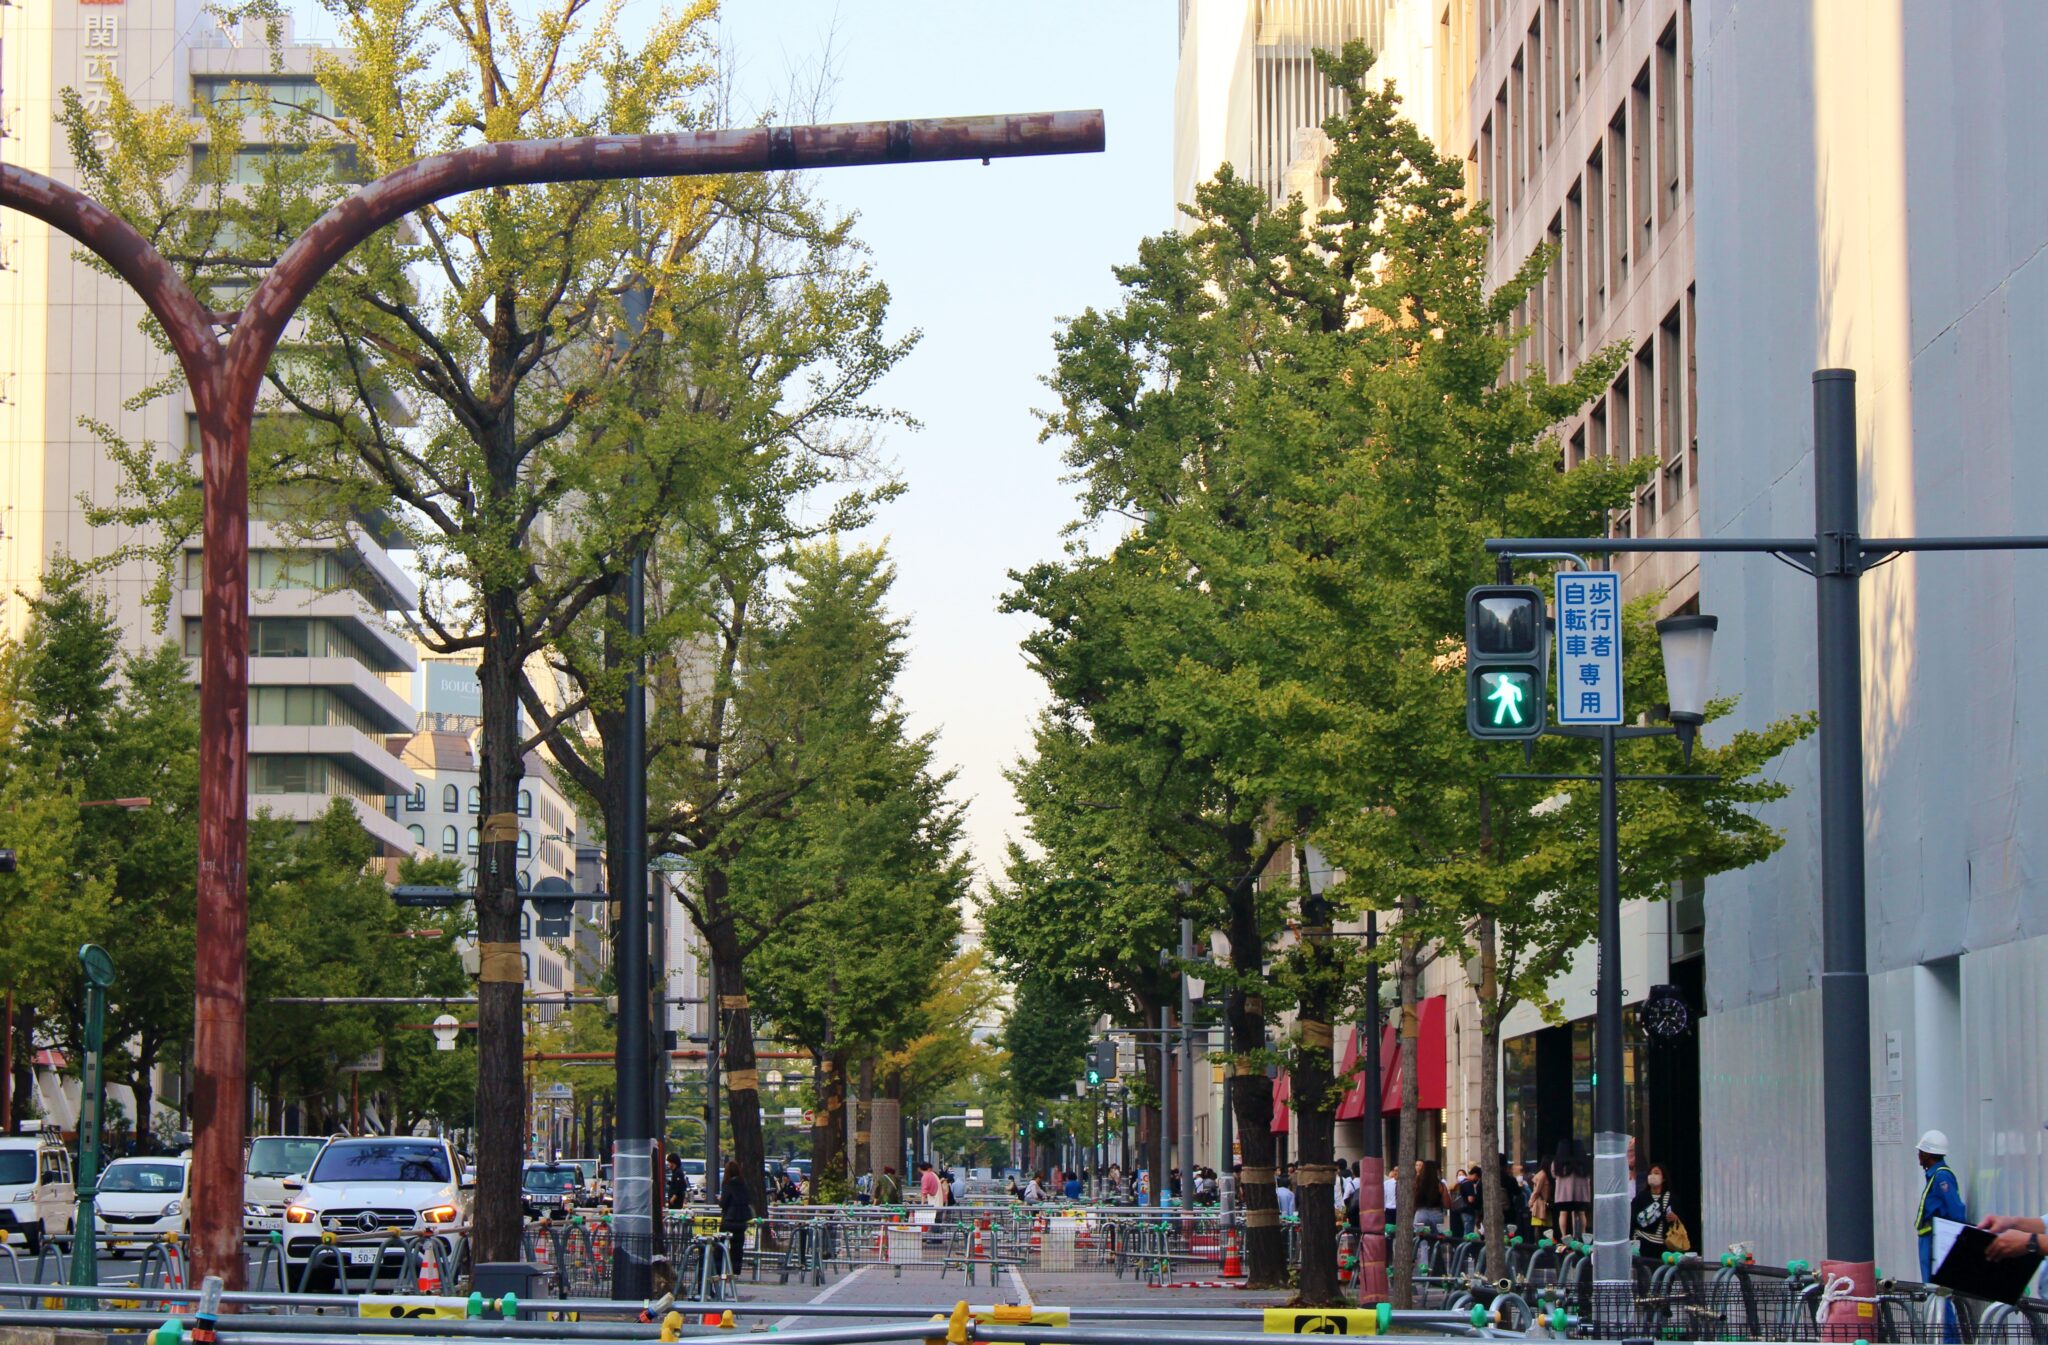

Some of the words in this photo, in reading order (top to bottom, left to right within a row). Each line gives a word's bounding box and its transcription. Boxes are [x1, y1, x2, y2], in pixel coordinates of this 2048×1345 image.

[1564, 583, 1587, 657] 自転車
[1589, 581, 1612, 657] 歩行者
[1579, 663, 1600, 714] 専用
